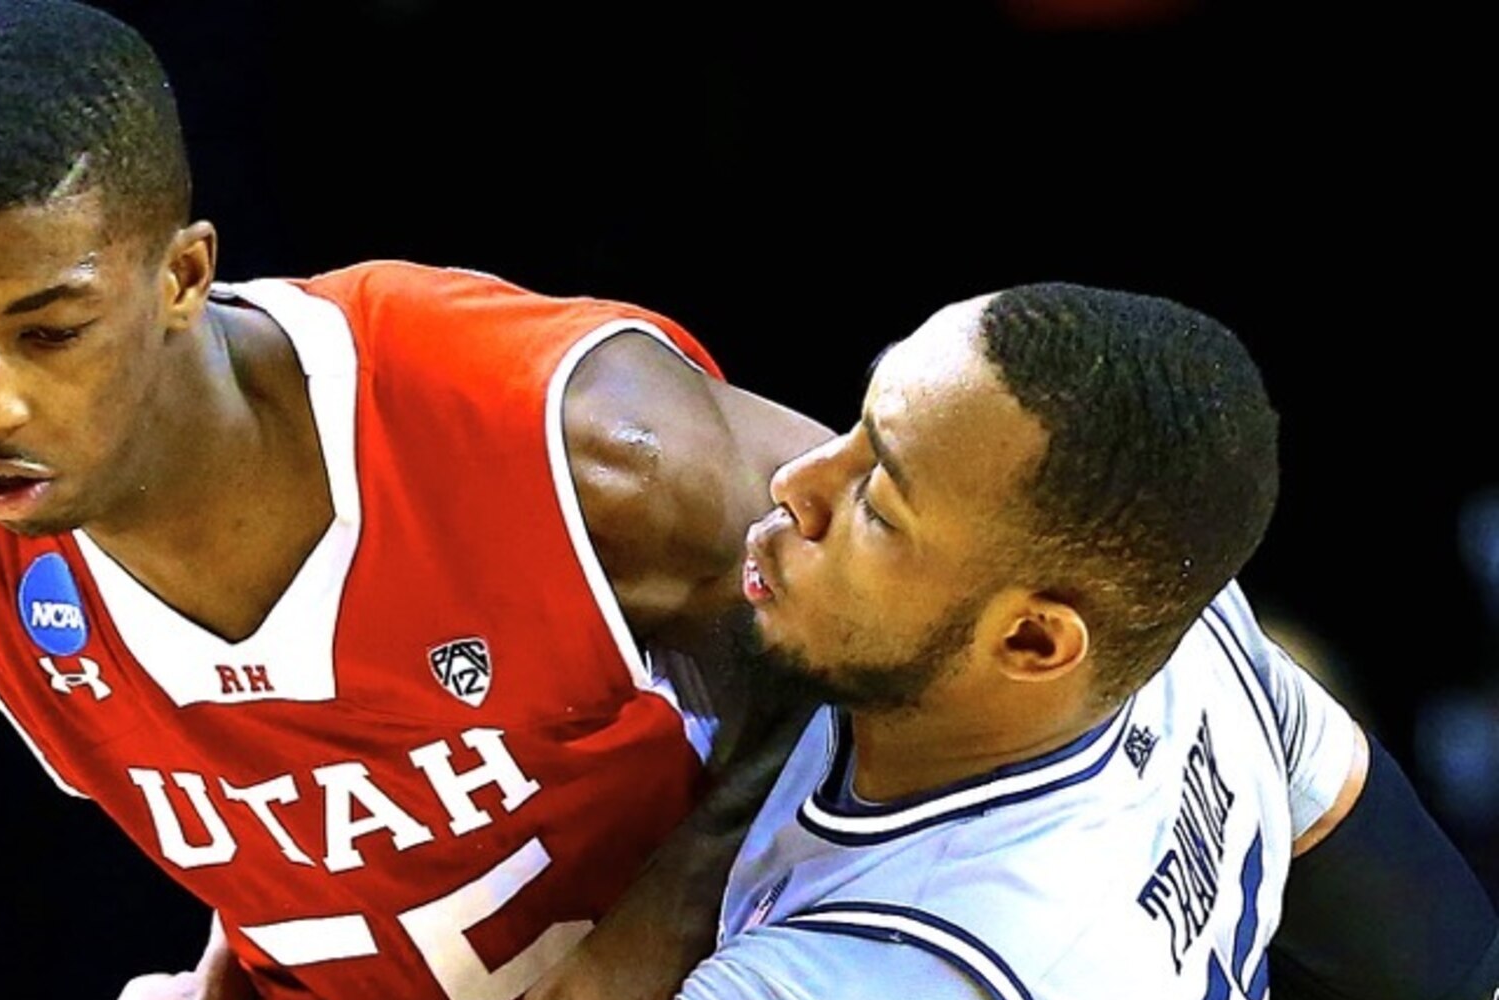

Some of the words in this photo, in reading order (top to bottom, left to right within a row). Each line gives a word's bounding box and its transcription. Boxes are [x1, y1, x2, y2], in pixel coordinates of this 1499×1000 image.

[31, 601, 84, 629] NCAA
[215, 664, 275, 694] RH
[431, 640, 489, 687] PAC
[451, 667, 485, 696] 12
[127, 727, 542, 873] UTAH
[1136, 708, 1234, 976] TRAWICK
